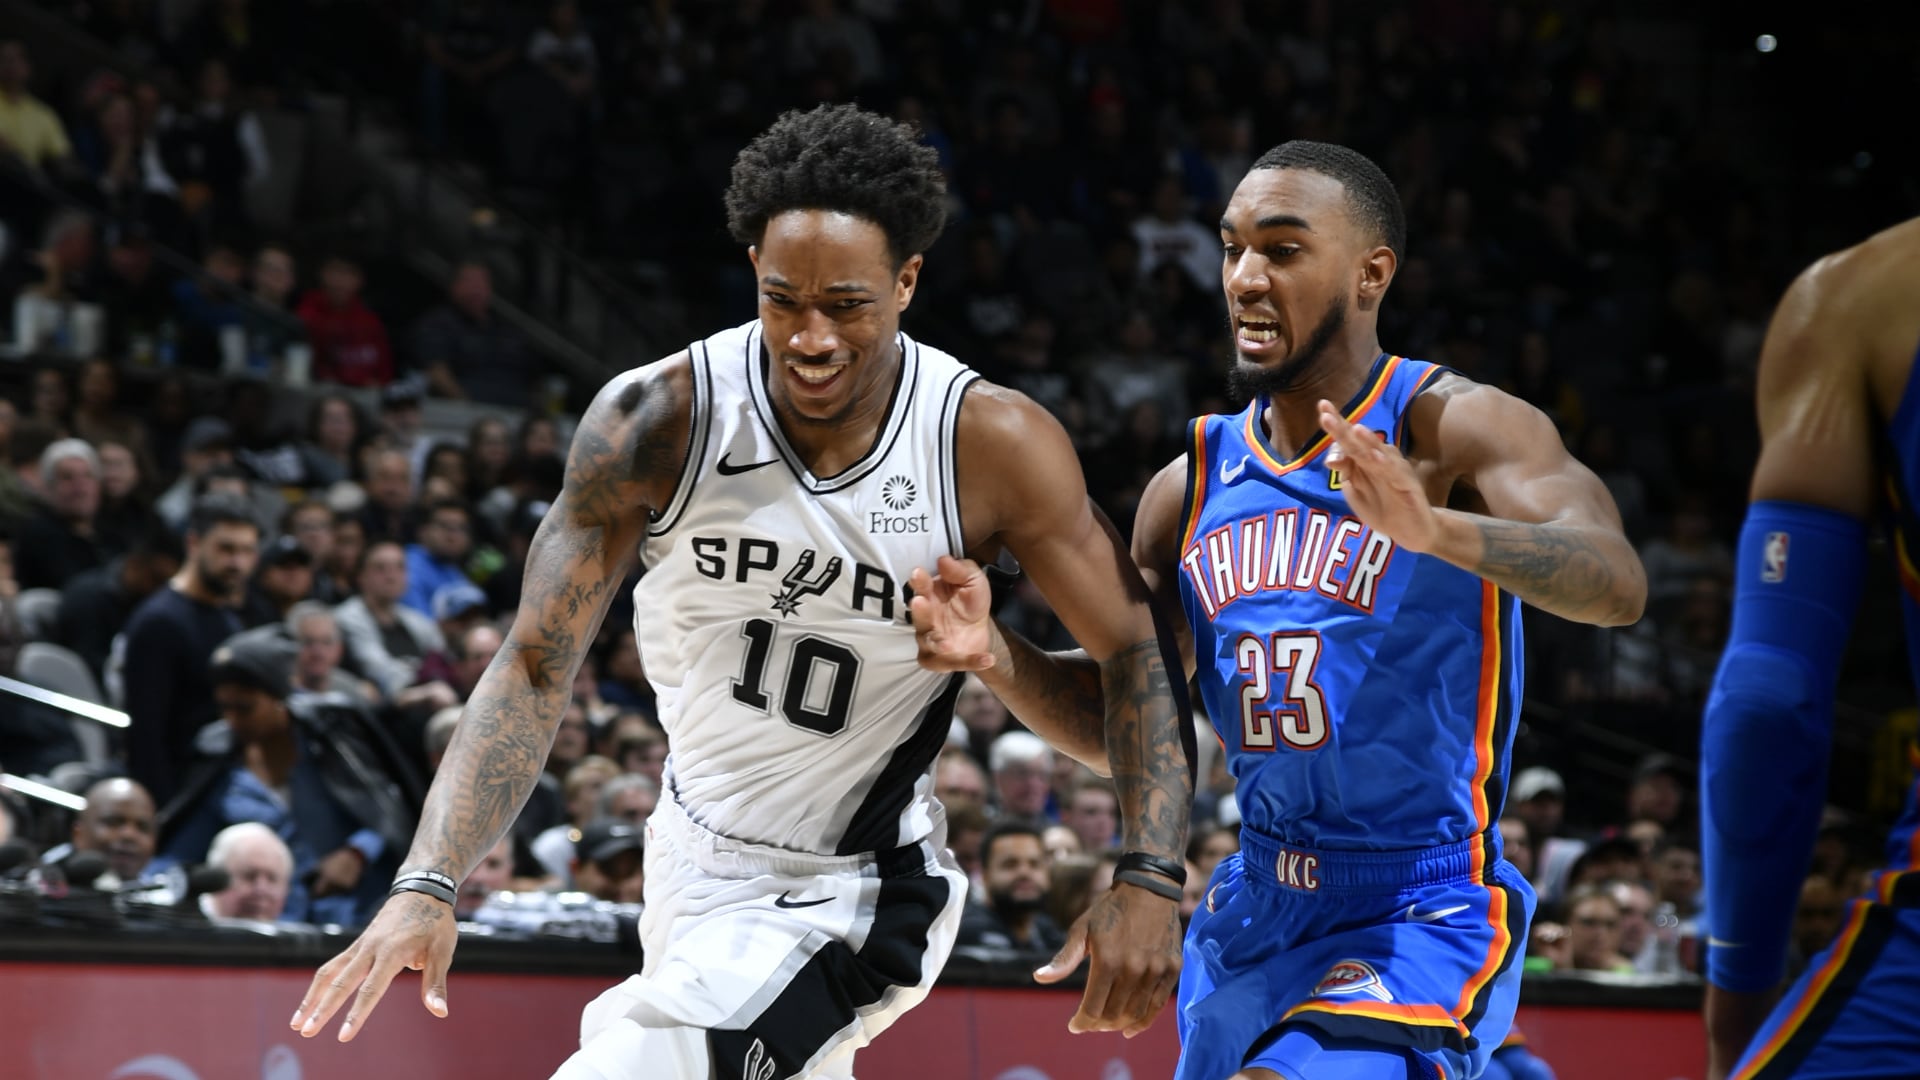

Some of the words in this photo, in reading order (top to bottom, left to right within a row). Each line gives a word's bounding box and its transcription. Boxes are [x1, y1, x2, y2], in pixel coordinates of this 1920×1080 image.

[869, 511, 929, 534] Frost
[1183, 507, 1397, 622] THUNDER
[691, 536, 914, 624] SPUR
[729, 618, 864, 739] 10
[1236, 630, 1332, 752] 23
[1276, 850, 1321, 890] OKC
